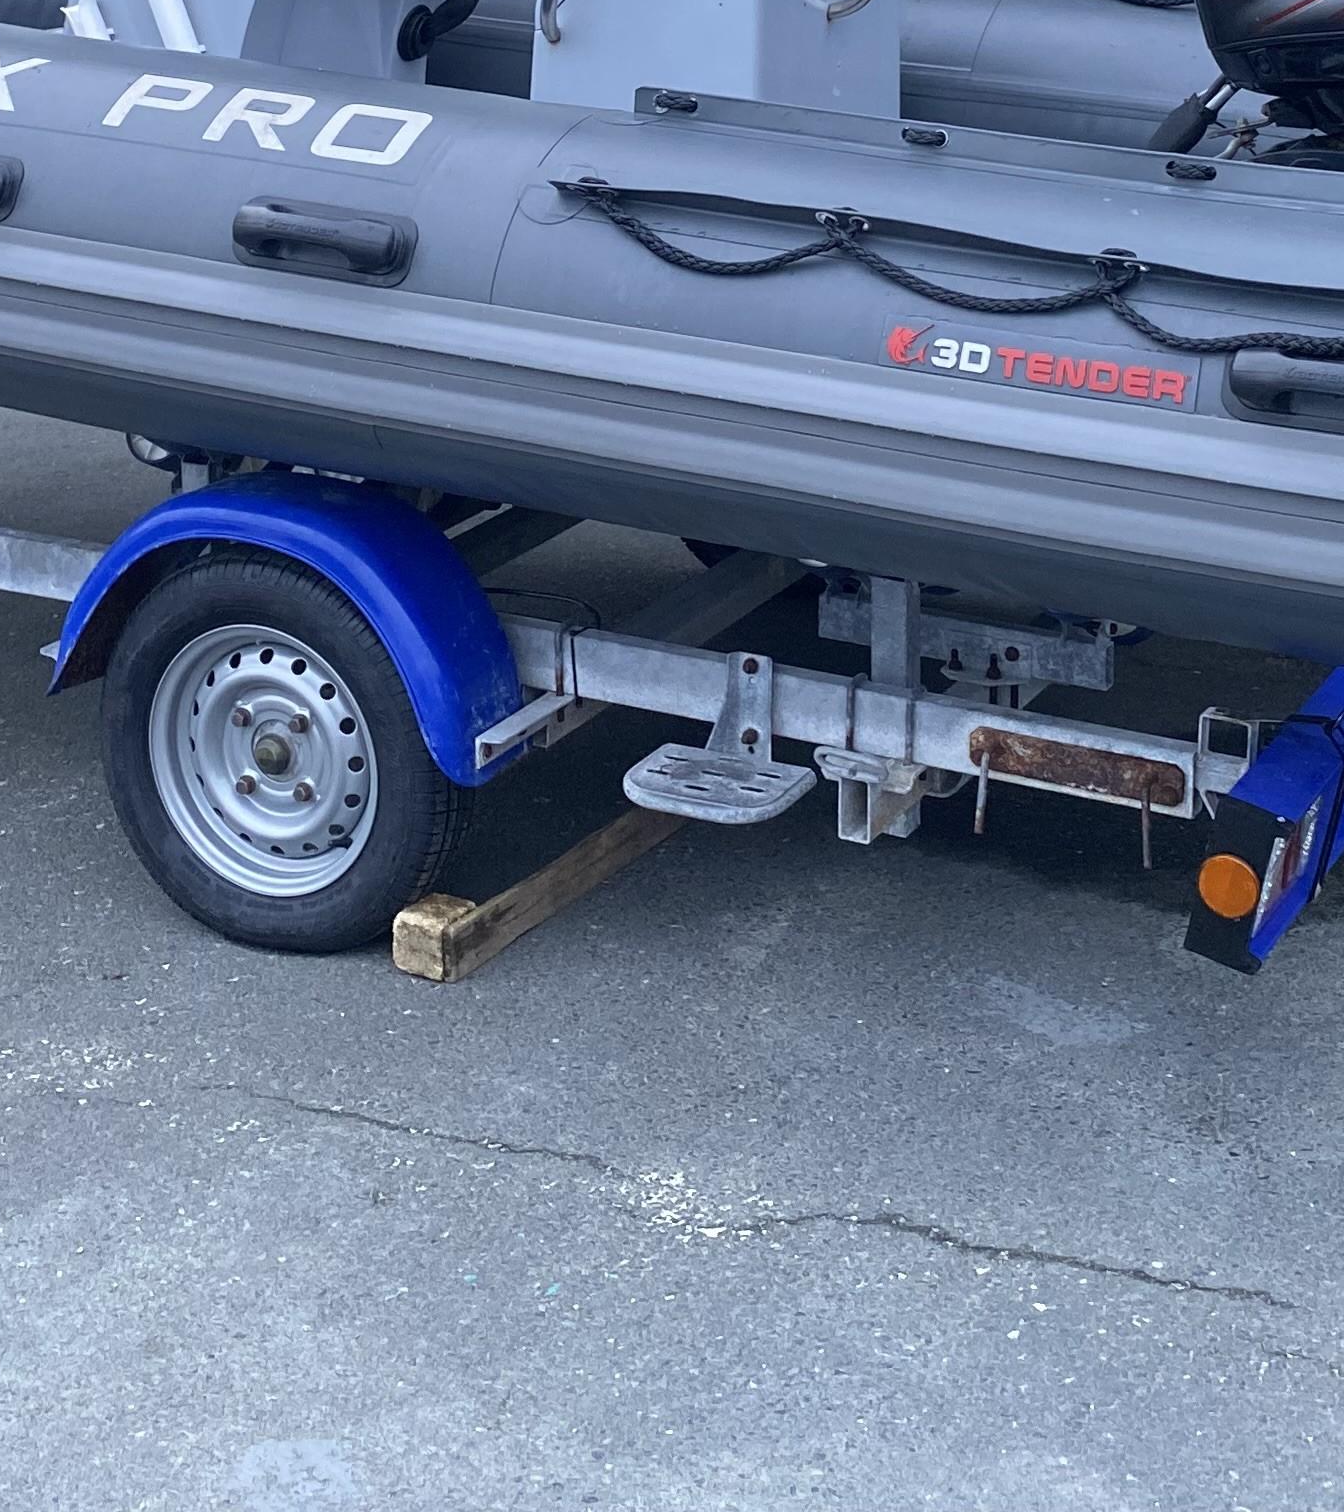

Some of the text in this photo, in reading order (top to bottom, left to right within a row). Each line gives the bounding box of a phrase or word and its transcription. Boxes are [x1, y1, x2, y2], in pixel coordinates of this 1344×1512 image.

[102, 73, 434, 166] PRO
[930, 337, 1188, 405] 3D TENDER
